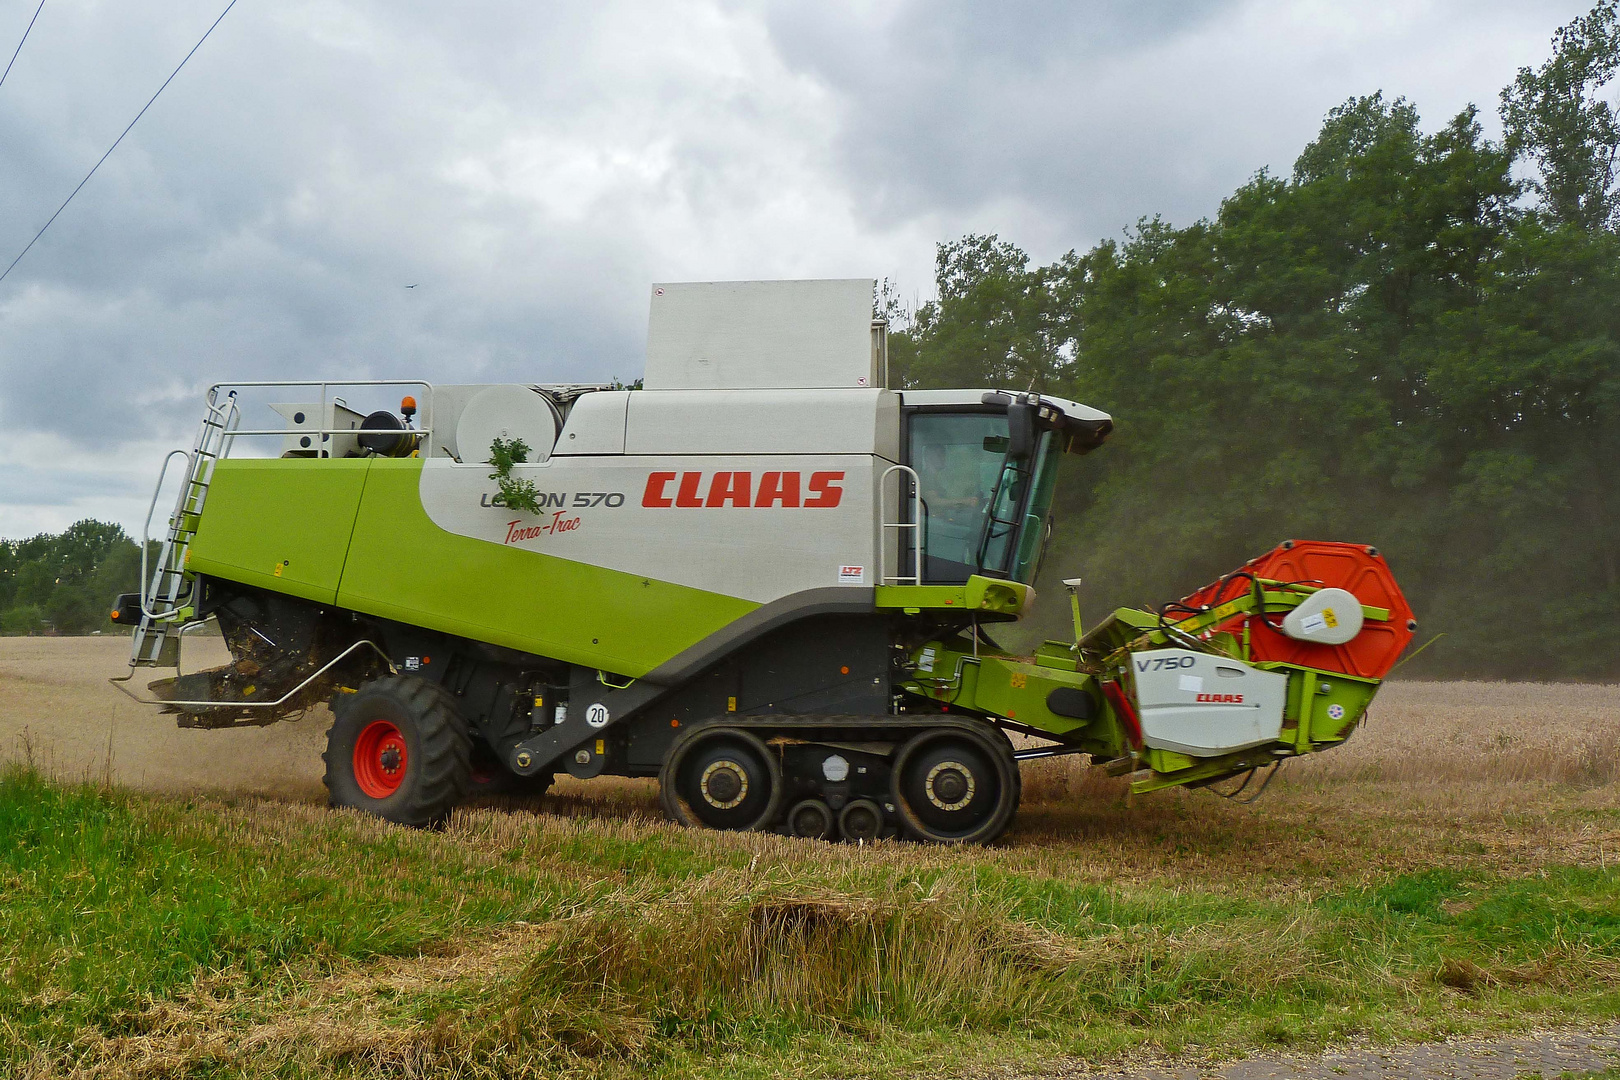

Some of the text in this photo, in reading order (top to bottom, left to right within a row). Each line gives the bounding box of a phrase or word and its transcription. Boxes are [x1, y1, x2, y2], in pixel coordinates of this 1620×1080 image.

[641, 471, 846, 508] CLAAS
[572, 492, 625, 508] 570
[504, 510, 581, 545] Terra-Trac
[842, 566, 862, 575] LTZ
[1196, 693, 1244, 703] CLAAS
[591, 708, 604, 722] 20
